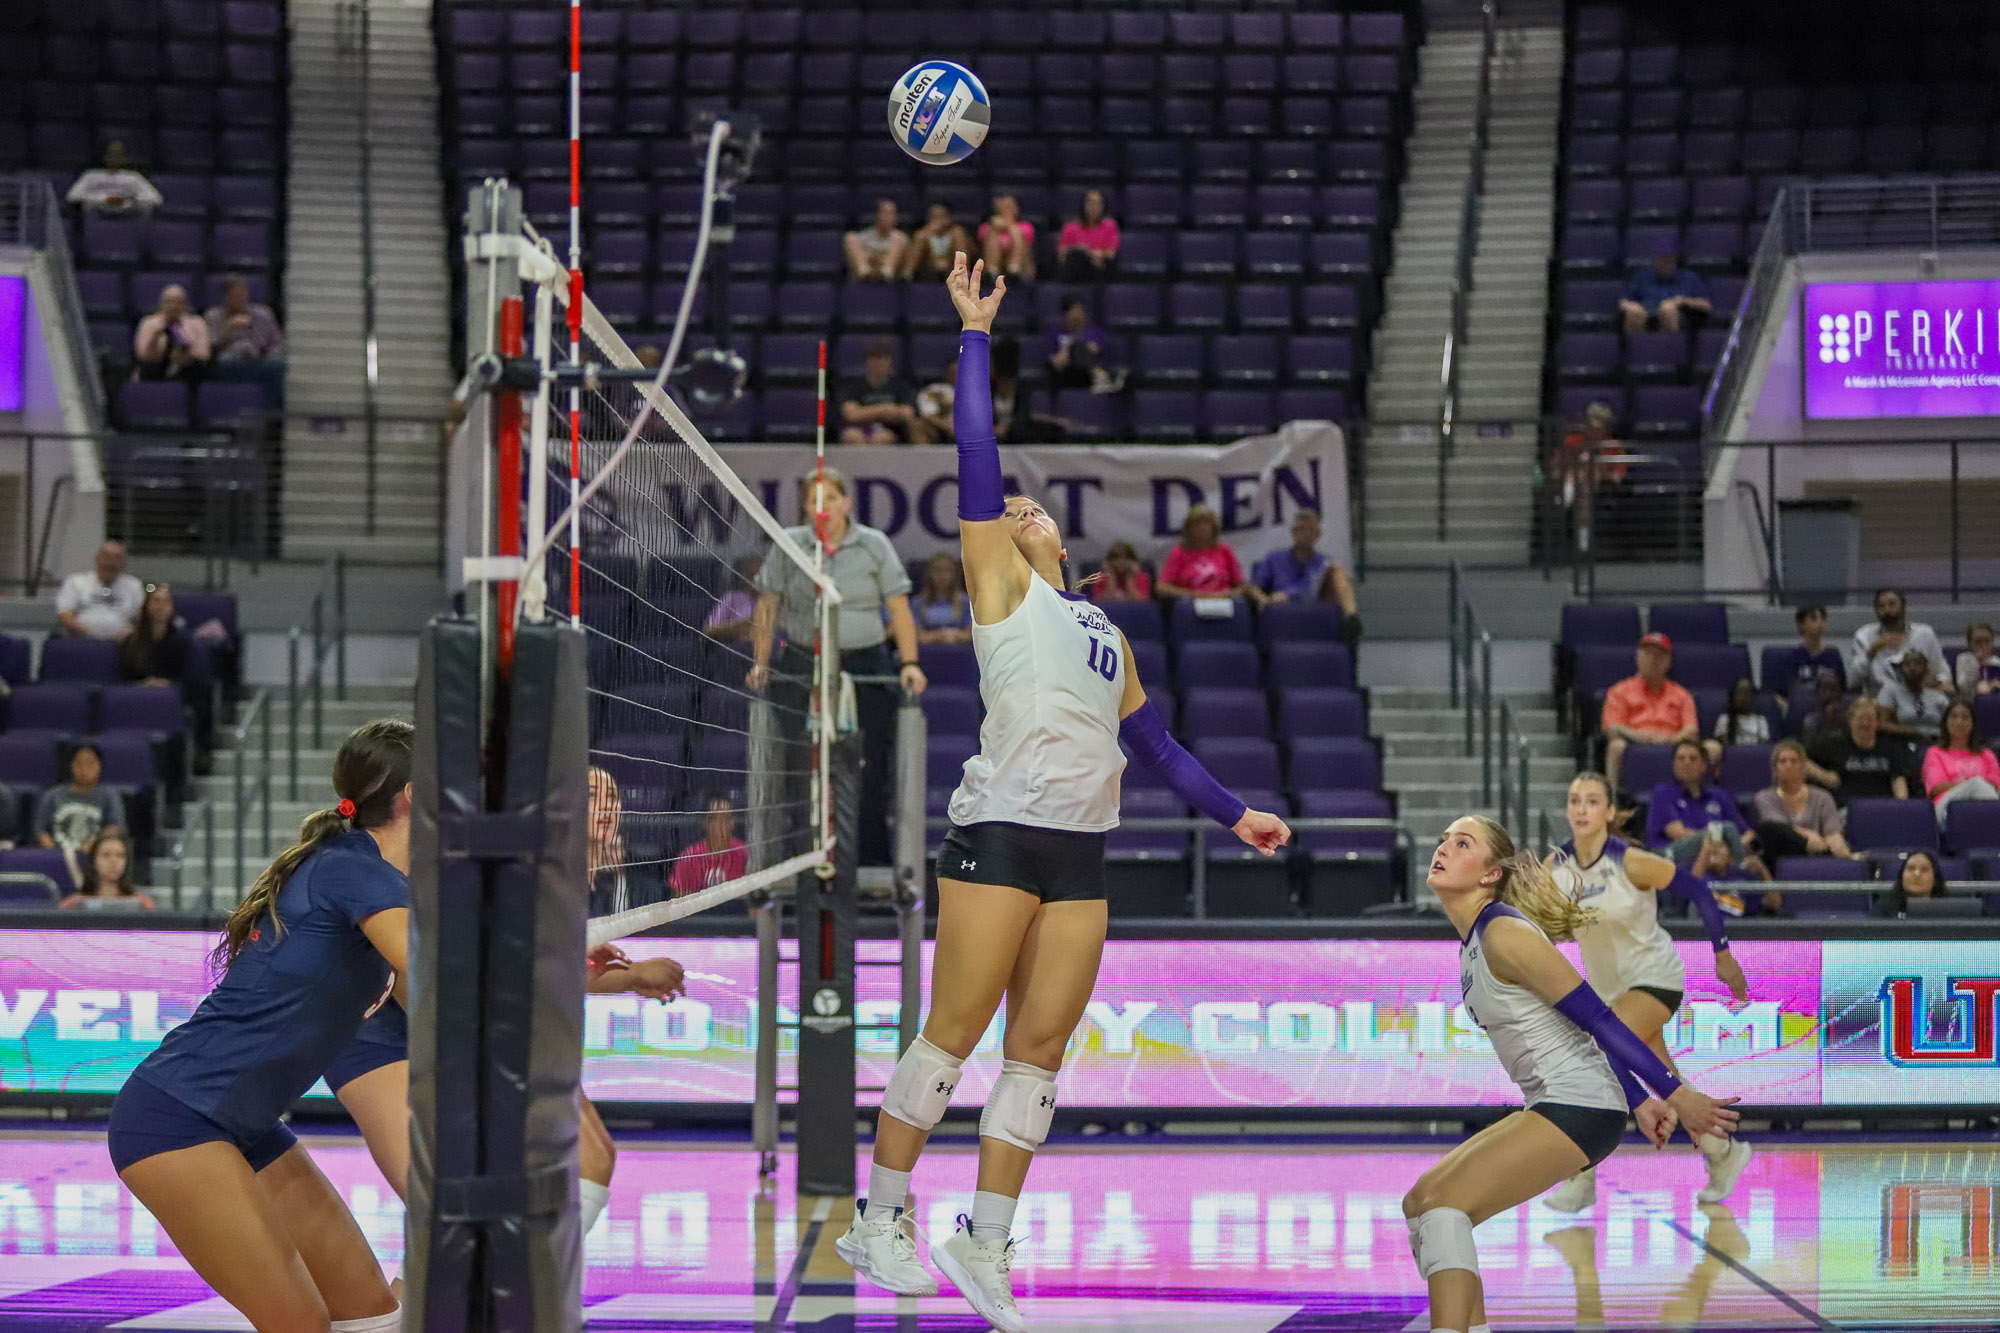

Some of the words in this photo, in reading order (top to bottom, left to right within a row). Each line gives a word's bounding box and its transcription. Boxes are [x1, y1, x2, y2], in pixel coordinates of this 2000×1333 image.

[899, 75, 933, 129] molten
[932, 124, 950, 146] Super
[947, 95, 963, 123] Touch
[1854, 308, 2000, 358] PERKI
[661, 475, 1103, 548] WIDCT
[1150, 457, 1322, 539] DEN
[1087, 635, 1118, 682] 10
